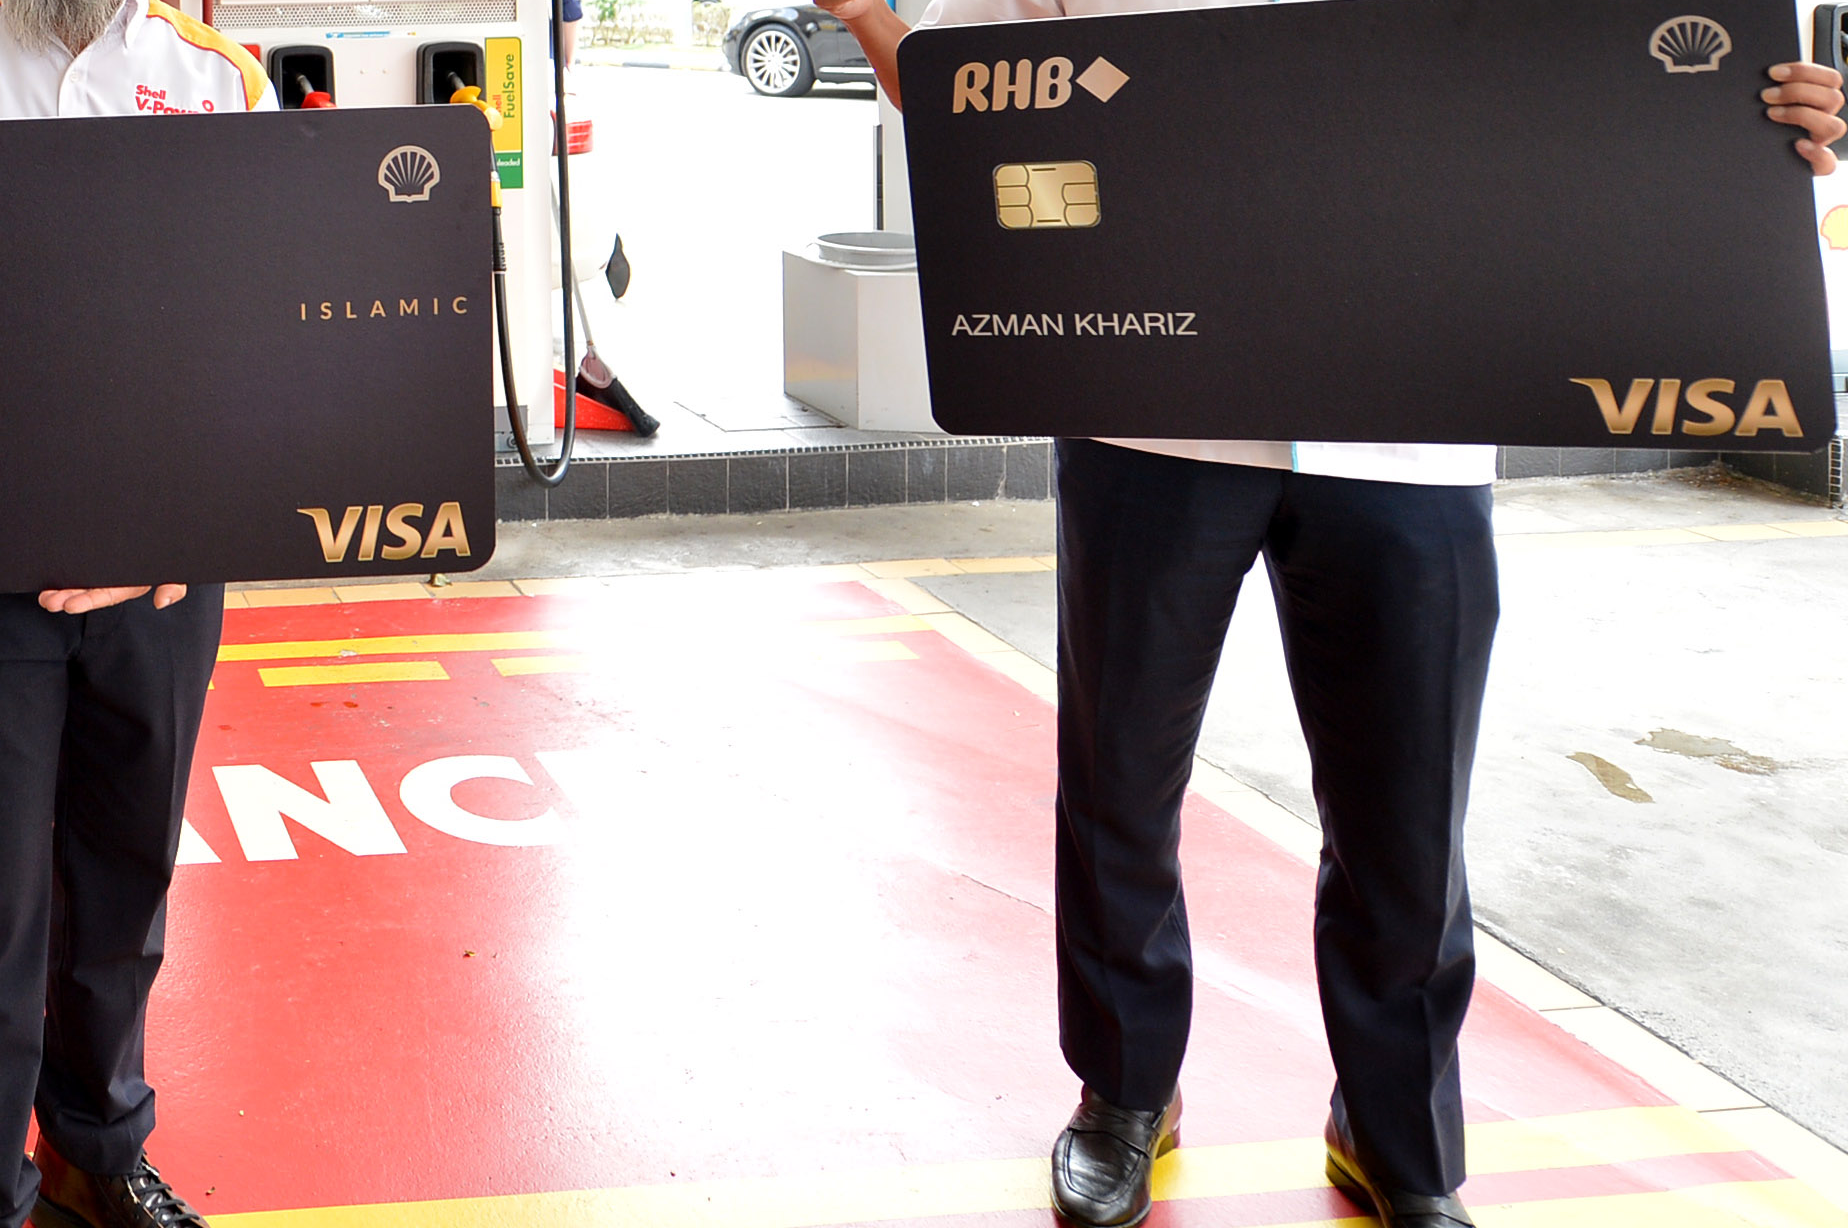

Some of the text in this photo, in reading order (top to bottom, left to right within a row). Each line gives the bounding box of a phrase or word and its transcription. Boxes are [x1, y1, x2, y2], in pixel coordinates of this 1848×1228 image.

[135, 84, 167, 101] Shell
[502, 53, 515, 118] FuelSave
[952, 56, 1074, 114] RHB
[300, 295, 469, 322] ISLAMIC
[952, 312, 1198, 336] AZMAN KHARIZ
[1569, 378, 1804, 437] VISA
[296, 501, 471, 563] VISA
